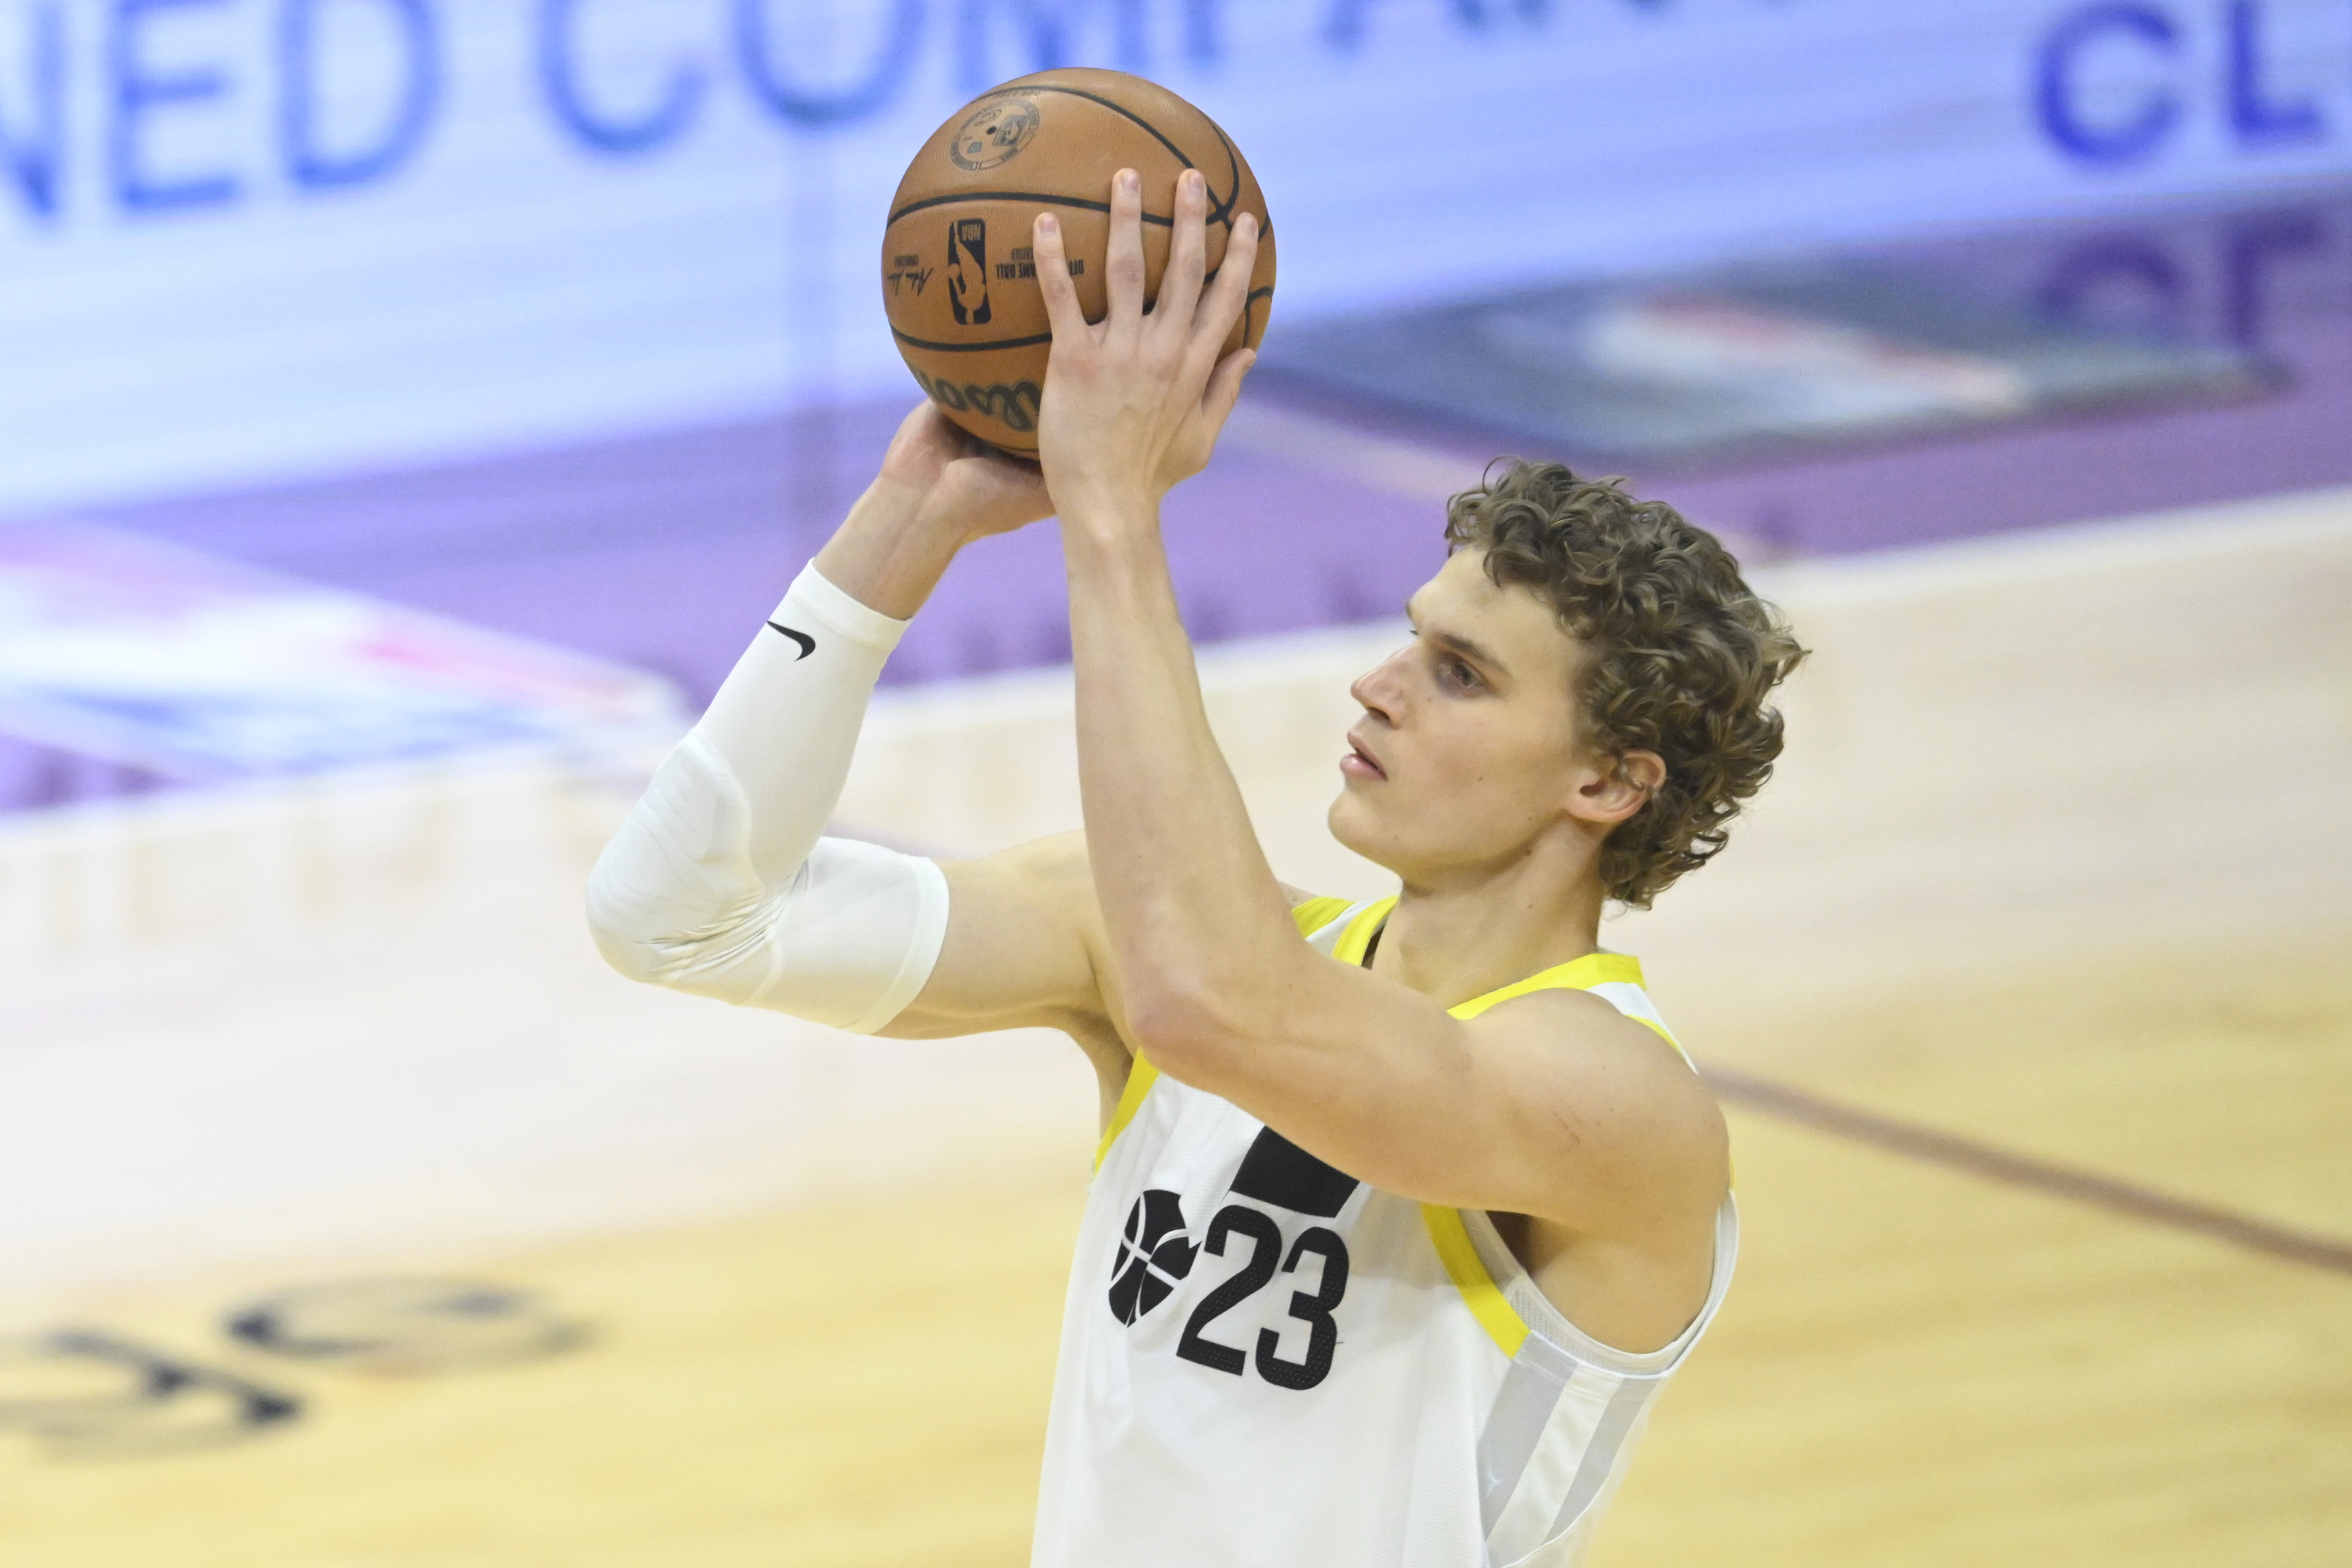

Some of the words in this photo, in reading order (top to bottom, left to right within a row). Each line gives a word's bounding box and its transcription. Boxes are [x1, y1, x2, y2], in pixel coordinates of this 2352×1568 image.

[996, 264, 1015, 280] BALL
[1018, 263, 1036, 279] AME
[1176, 1204, 1349, 1391] 23
